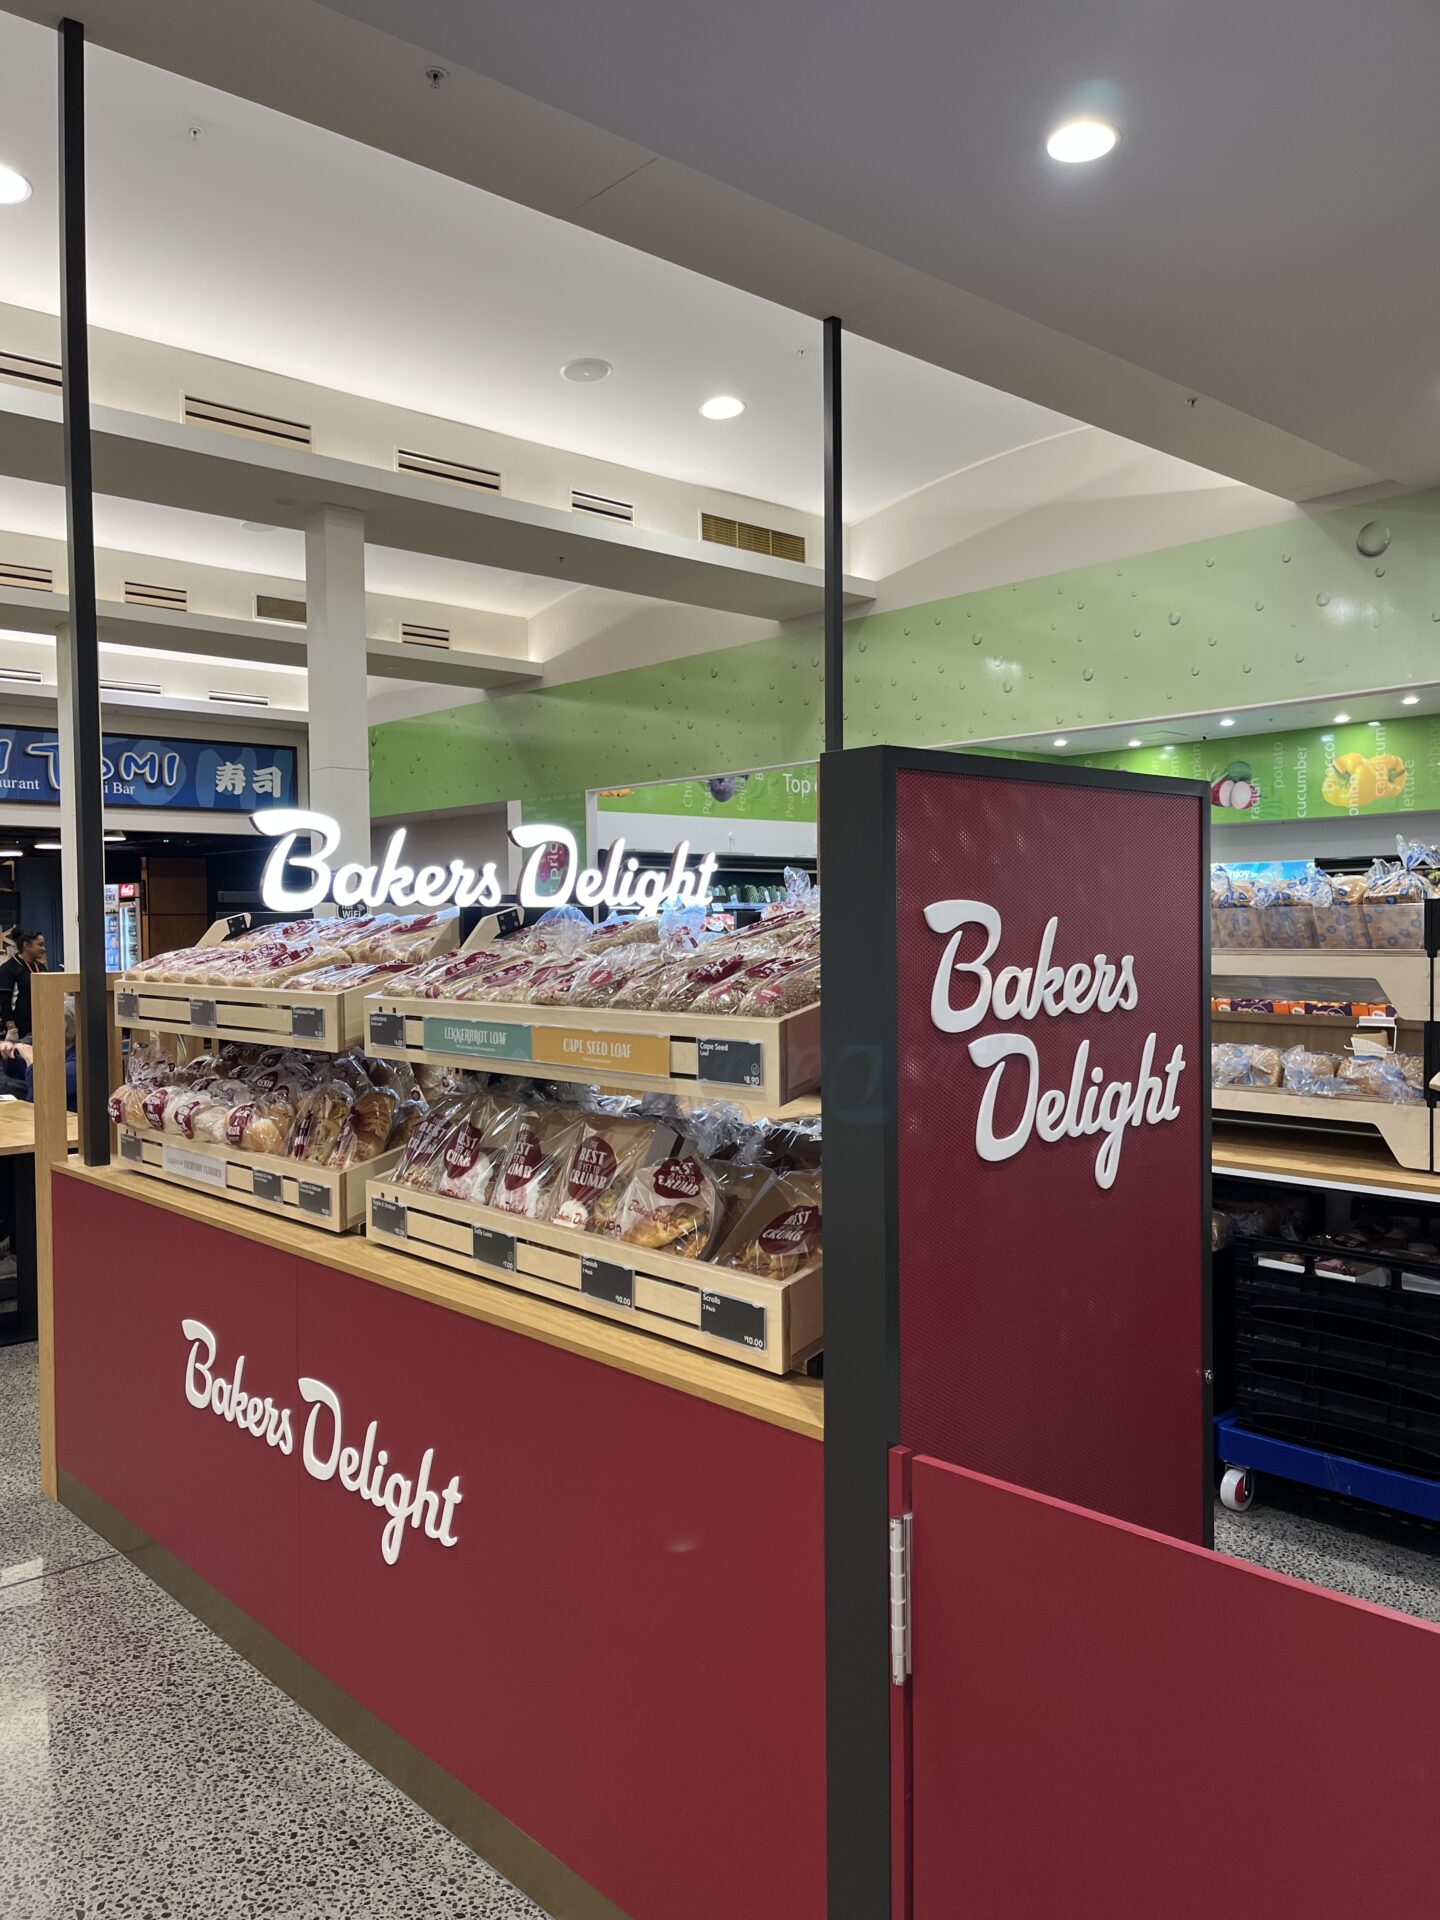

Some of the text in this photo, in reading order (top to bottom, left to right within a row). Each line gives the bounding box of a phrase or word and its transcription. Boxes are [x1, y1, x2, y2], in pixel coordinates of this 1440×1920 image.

[26, 742, 180, 789] TMI
[216, 761, 282, 798] 寿司
[1273, 742, 1286, 789] potato
[1375, 726, 1387, 797] capsicum
[0, 779, 40, 790] urant
[113, 781, 136, 794] Bar
[782, 773, 811, 798] Top
[1249, 777, 1260, 819] radish
[1294, 746, 1307, 818] cucumber
[1349, 774, 1359, 816] onion
[248, 808, 719, 919] Bakers Delight
[923, 898, 1138, 1034] Bakers
[444, 1026, 508, 1045] LEKKERBROT LOAF
[563, 1038, 632, 1058] CAPE SEED LOAF
[700, 1042, 729, 1051] Cape Seed
[967, 1032, 1186, 1190] Delight
[579, 1148, 608, 1165] BEST
[569, 1168, 607, 1190] CRUMB
[702, 1293, 721, 1305] Scrolls
[743, 1335, 763, 1348] $10.00
[182, 1318, 463, 1566] Bakers Delight
